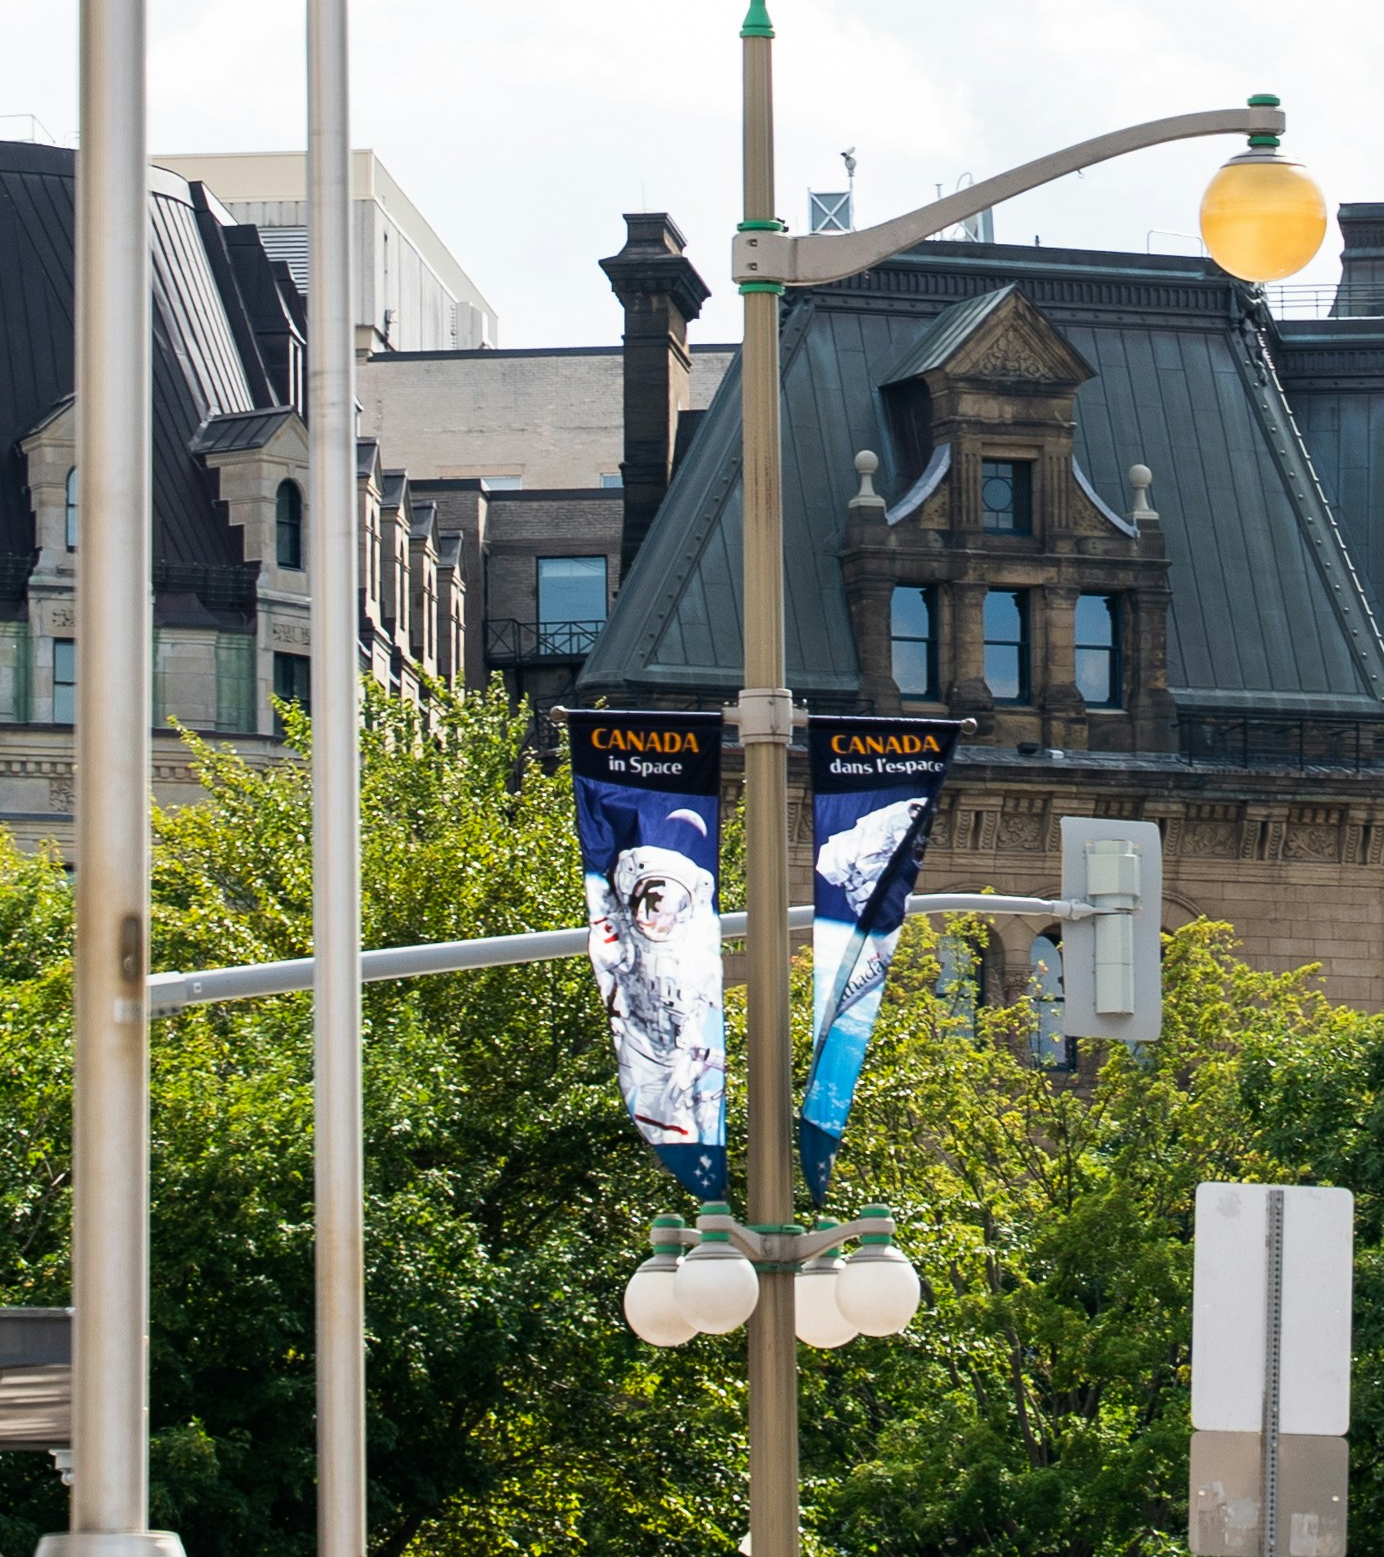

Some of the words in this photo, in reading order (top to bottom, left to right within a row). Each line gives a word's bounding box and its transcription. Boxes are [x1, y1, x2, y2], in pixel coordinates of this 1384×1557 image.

[591, 728, 699, 753] CANADA
[831, 735, 941, 755] CANADA
[609, 755, 625, 771] in
[629, 756, 683, 777] Space
[830, 758, 874, 774] dans
[876, 758, 945, 775] l'espace
[841, 960, 886, 1002] anada
